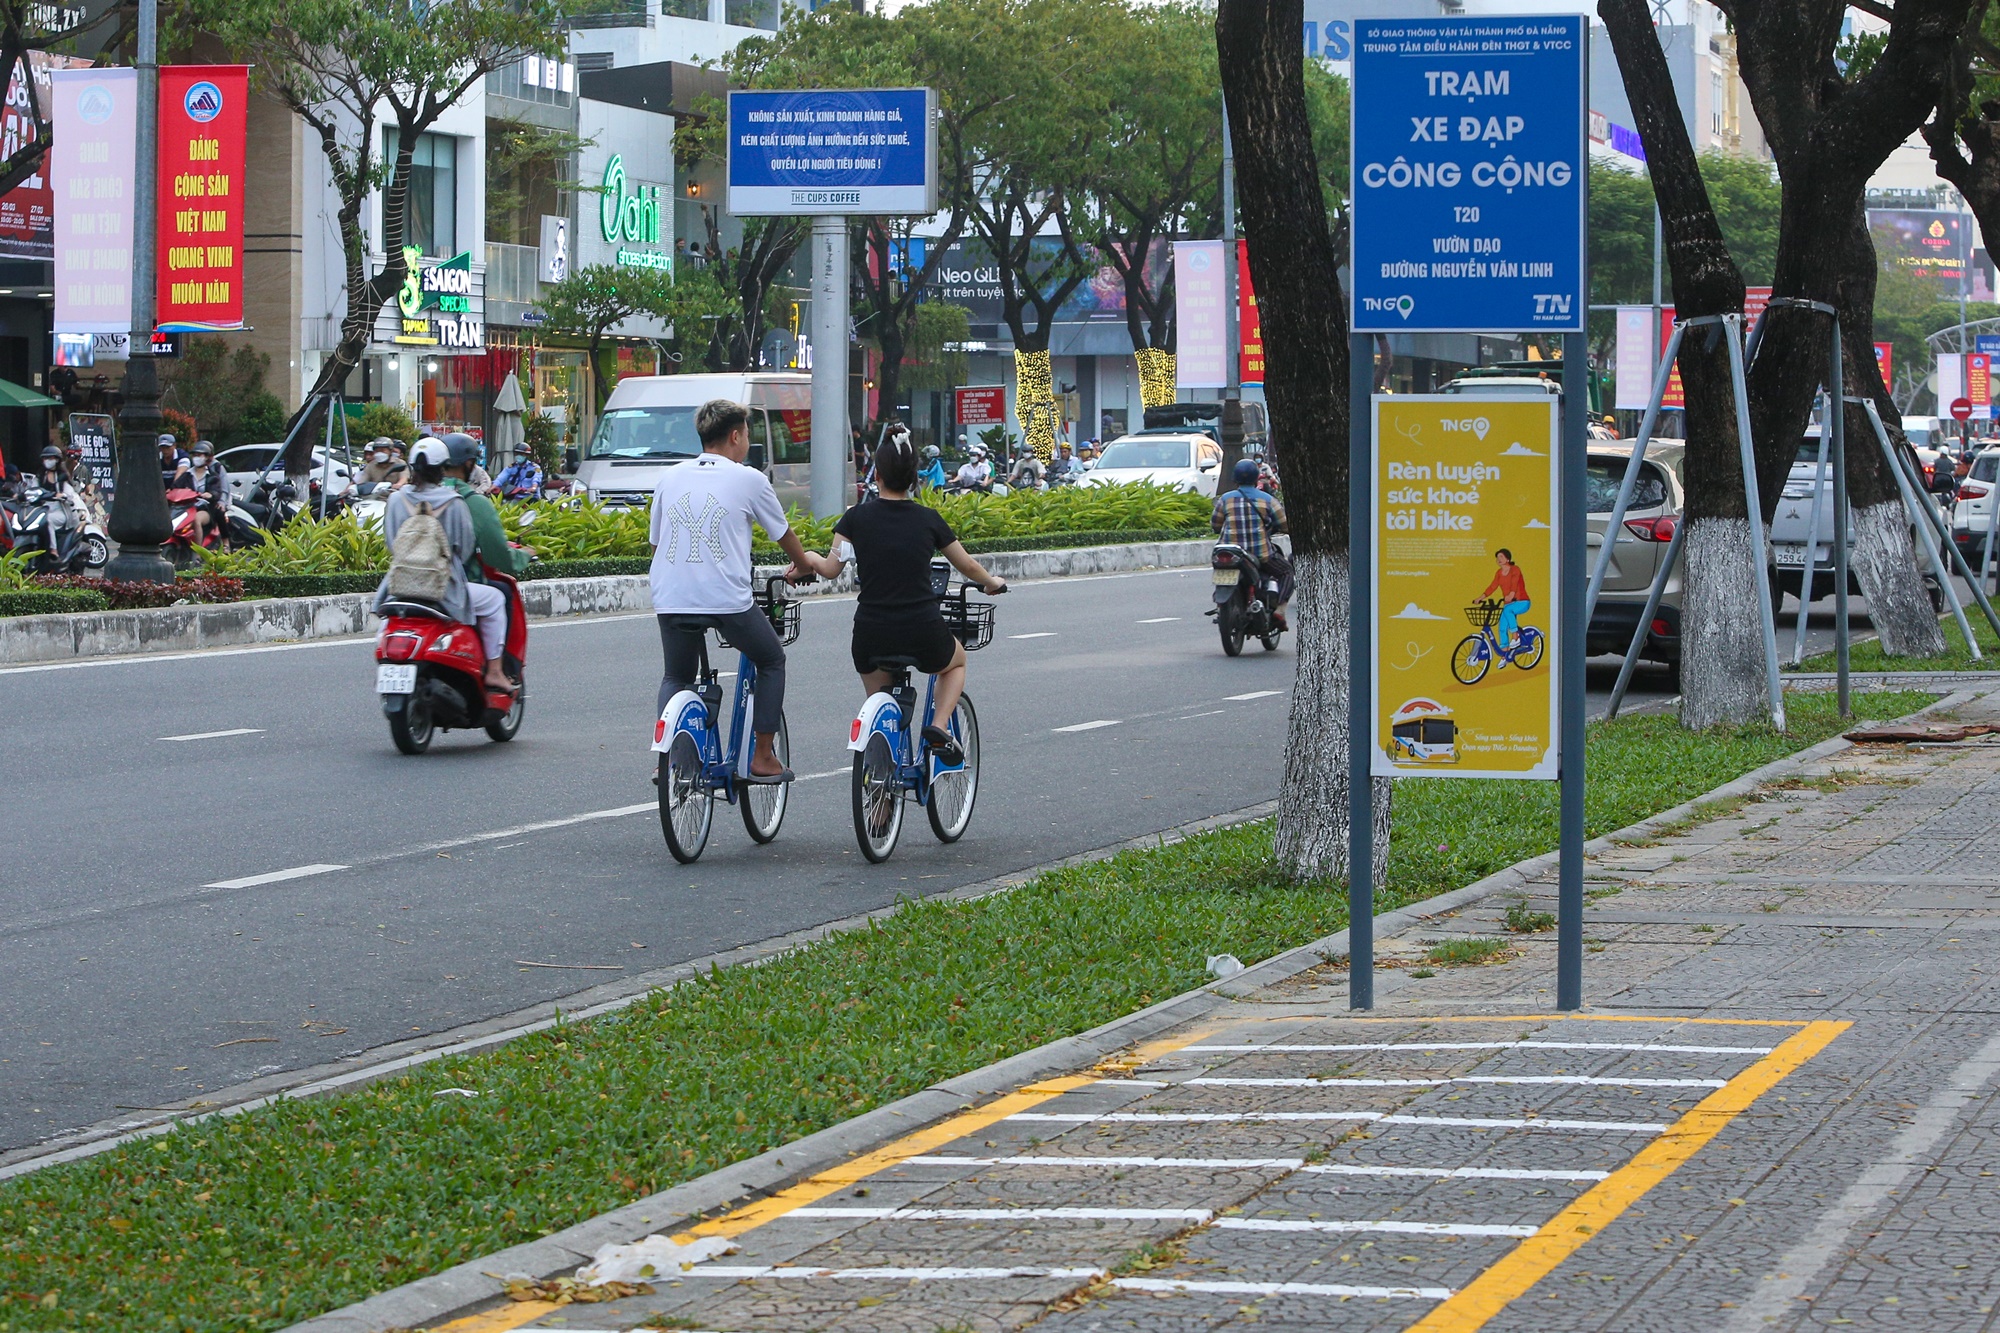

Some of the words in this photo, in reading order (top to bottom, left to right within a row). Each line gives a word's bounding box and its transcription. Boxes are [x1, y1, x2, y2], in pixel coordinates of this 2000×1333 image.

[1368, 28, 1379, 38] SỞ
[1382, 29, 1404, 37] GIAO
[1407, 27, 1437, 37] THÔNG
[1440, 27, 1457, 38] VẬN
[1460, 26, 1472, 36] TẢI
[1474, 26, 1503, 36] THÀNH
[1505, 25, 1524, 36] PHỐ
[1526, 25, 1539, 35] ĐÀ
[1363, 43, 1397, 53] TRUNG
[1400, 41, 1420, 53] TÂM
[1424, 38, 1446, 52] ĐIỀU
[1449, 40, 1478, 52] HÀNH
[1482, 40, 1501, 51] ĐÈN
[1505, 41, 1529, 50] THGT
[1533, 42, 1540, 50] &
[1543, 40, 1572, 50] VTCC
[1425, 70, 1510, 103] TRẠM
[748, 109, 775, 122] KHÔNG
[776, 108, 793, 122] SẢN
[794, 106, 815, 123] XUẤT,
[816, 111, 835, 122] KINH
[837, 111, 863, 122] DOANH
[864, 109, 886, 122] HÀNG
[887, 107, 903, 122] GIẢ,
[741, 133, 758, 146] KÉM
[759, 132, 780, 146] CHẤT
[781, 134, 806, 148] LƯỢNG
[807, 132, 824, 146] ẢNH
[825, 132, 851, 146] HƯỞNG
[853, 131, 869, 145] ĐẾN
[870, 132, 886, 145] SỨC
[1410, 117, 1448, 142] XE
[1458, 116, 1525, 149] ĐẠP
[189, 134, 219, 161] ĐẢNG
[797, 157, 810, 172] LỢI
[811, 156, 835, 170] NGƯỜI
[836, 157, 854, 170] TIÊU
[854, 157, 876, 170] DÙNG
[877, 159, 882, 170] !
[1362, 155, 1462, 189] CÔNG
[1471, 154, 1572, 194] CỘNG
[174, 171, 205, 201] CỘNG
[207, 169, 230, 197] SẢN
[600, 153, 660, 244] Oahi
[790, 192, 805, 203] THE
[807, 192, 829, 203] CUPS
[830, 192, 861, 203] COFFEE
[176, 207, 200, 236] VIỆT
[202, 210, 227, 232] NAM
[1454, 206, 1480, 223] T20
[1433, 235, 1470, 253] VƯỜN
[1473, 238, 1501, 256] DẠO
[168, 246, 205, 271] QUANG
[206, 246, 233, 268] VINH
[1381, 259, 1428, 278] ĐƯỜNG
[1431, 257, 1487, 278] NGUYỄN
[1491, 260, 1518, 278] VĂN
[1522, 263, 1554, 278] LINH
[429, 267, 472, 294] SAIGON
[937, 267, 972, 284] Neo
[171, 279, 203, 305] MUÔN
[205, 278, 230, 304] NĂM
[952, 287, 976, 298] trên
[439, 295, 471, 314] SPECIAL
[1533, 294, 1572, 314] TN
[438, 314, 481, 348] TRÂN
[74, 434, 92, 448] SALE
[94, 447, 99, 458] 6
[92, 466, 111, 477] 26-27
[1388, 460, 1431, 480] Rèn
[1436, 460, 1500, 485] luyện
[1387, 486, 1424, 504] sức
[1427, 485, 1480, 505] khoẻ
[665, 491, 730, 566] NY
[1386, 509, 1416, 530] tôi
[1421, 509, 1474, 530] bike
